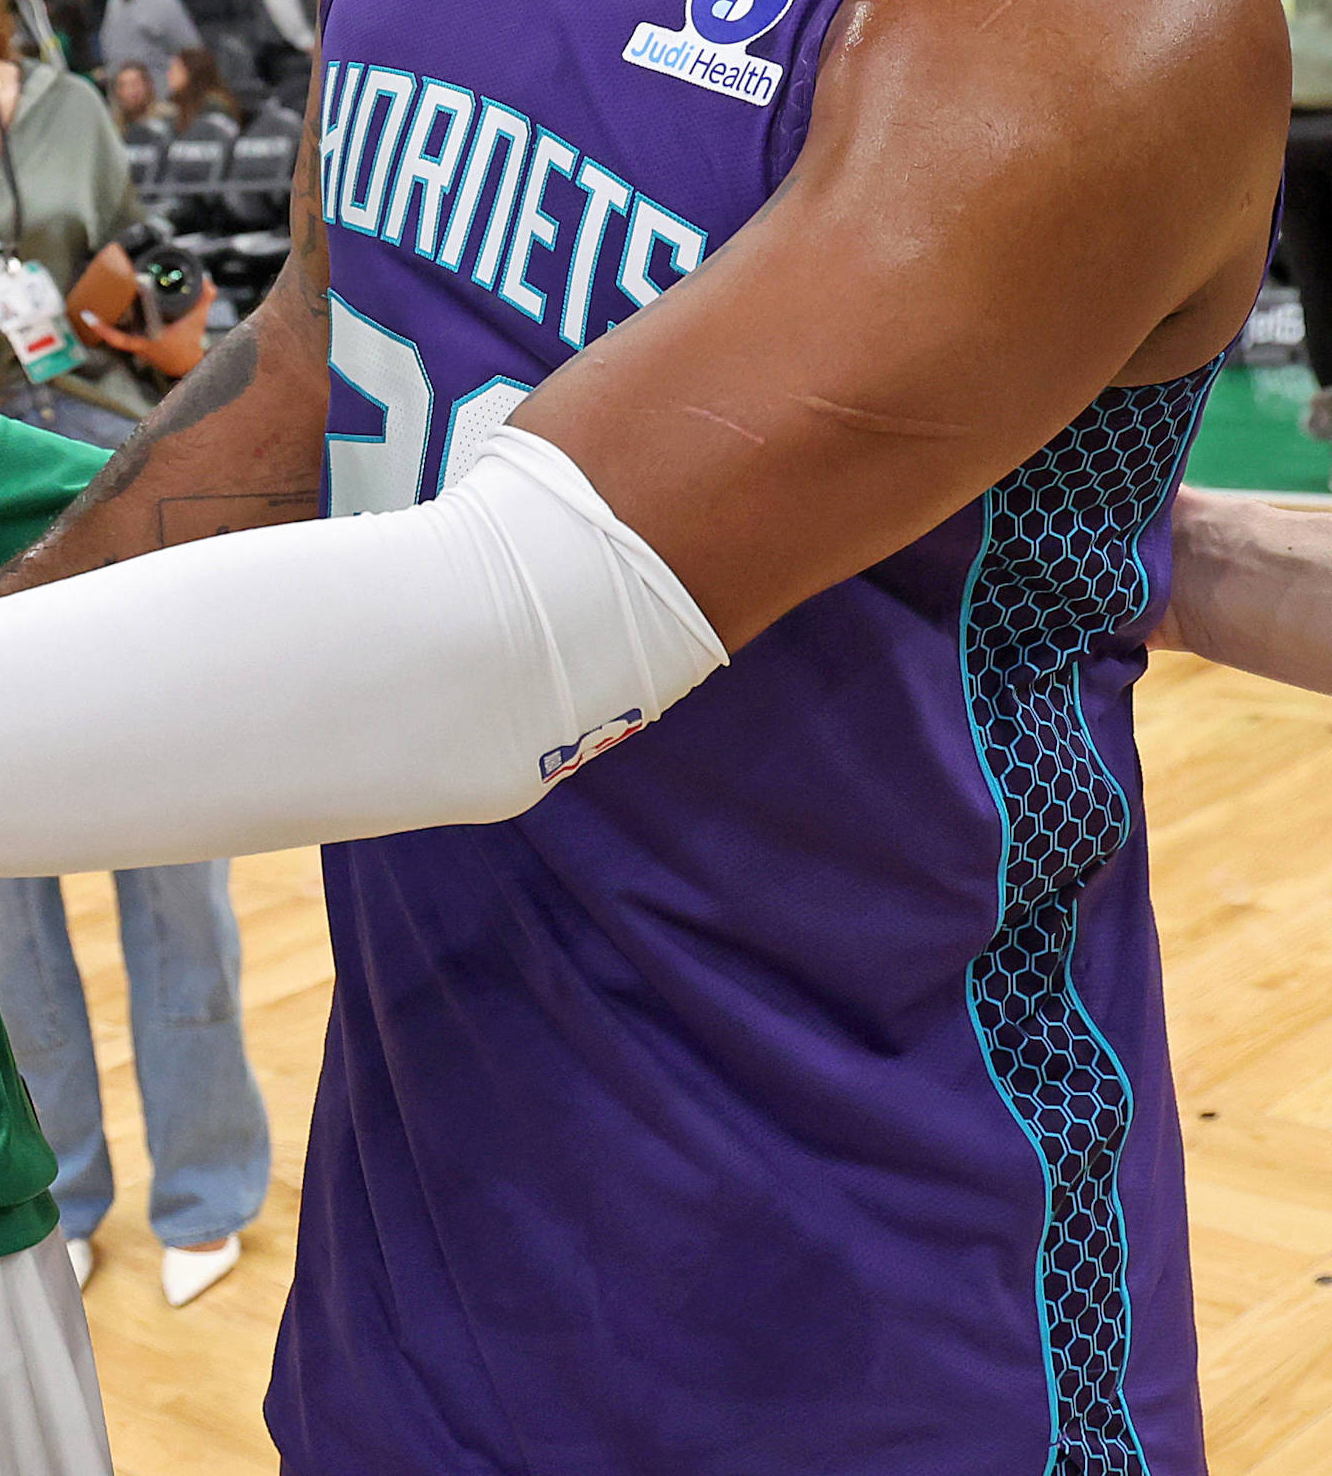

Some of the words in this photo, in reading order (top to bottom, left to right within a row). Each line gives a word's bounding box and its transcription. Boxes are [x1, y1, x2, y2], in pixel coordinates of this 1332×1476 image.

[631, 32, 694, 71] Judi
[689, 49, 773, 100] Health
[319, 61, 708, 351] HORNETS
